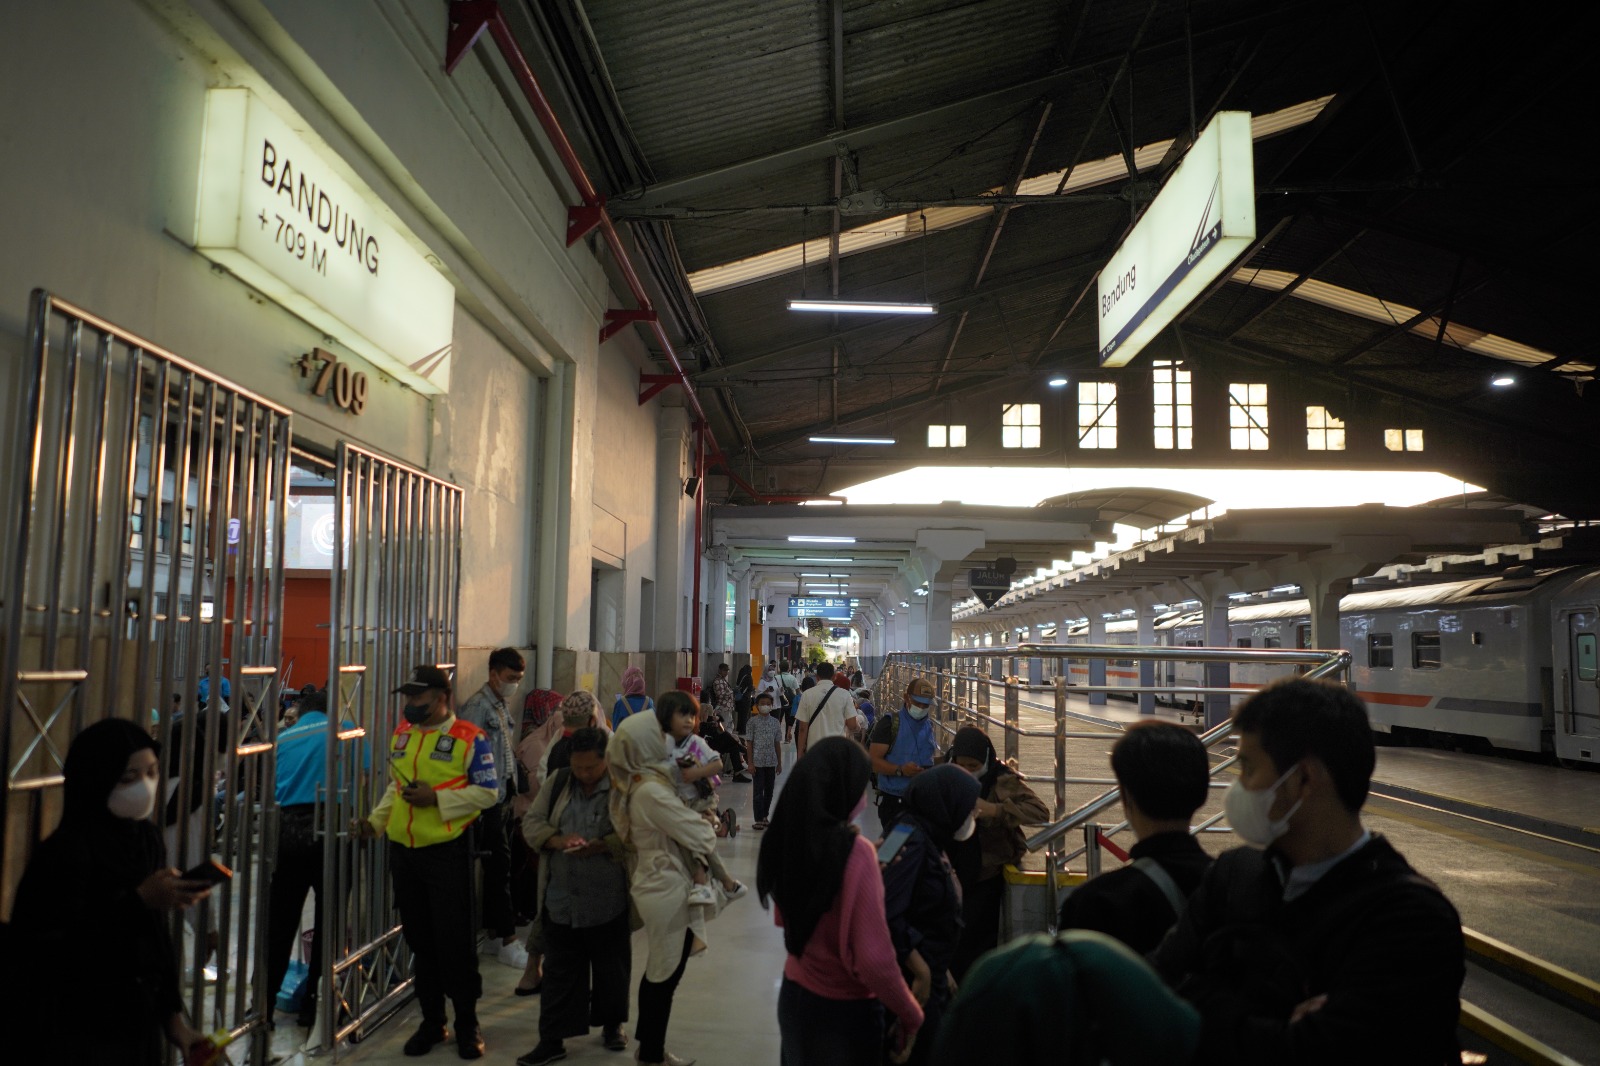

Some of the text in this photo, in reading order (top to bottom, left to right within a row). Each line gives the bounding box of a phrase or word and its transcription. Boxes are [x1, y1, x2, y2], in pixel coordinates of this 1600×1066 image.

[261, 138, 380, 277] BANDUNG
[311, 241, 327, 276] M
[1102, 264, 1136, 318] Bandung
[986, 592, 994, 601] 1
